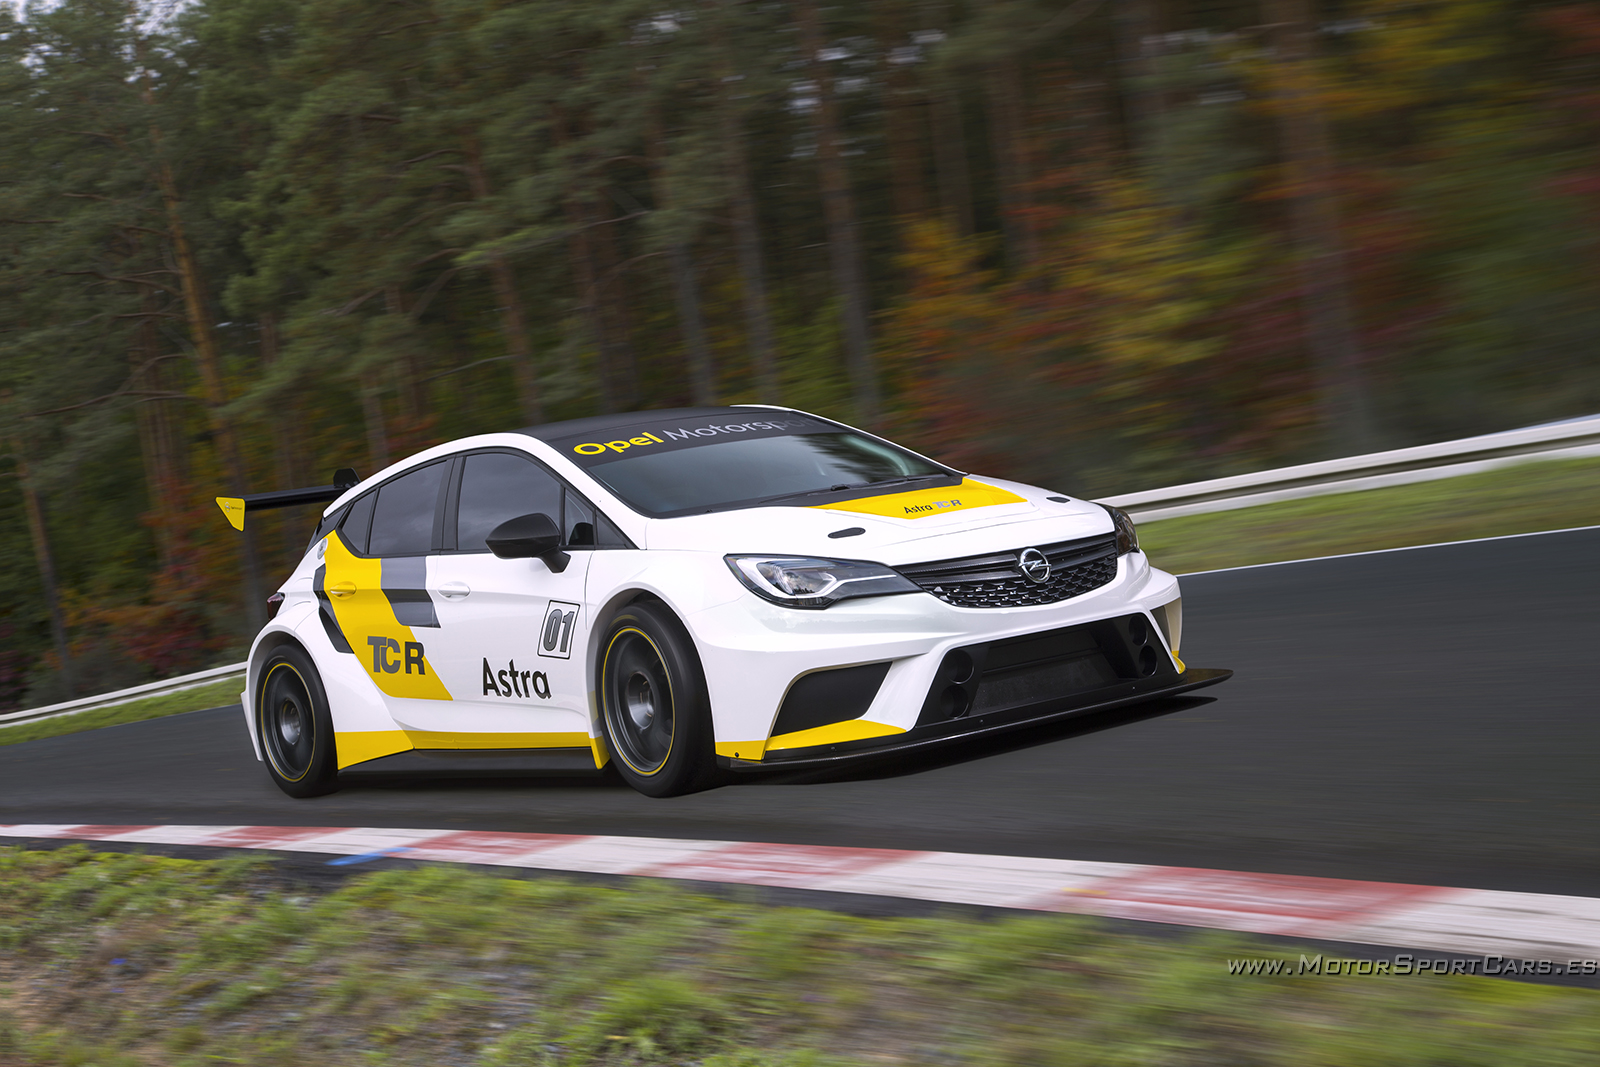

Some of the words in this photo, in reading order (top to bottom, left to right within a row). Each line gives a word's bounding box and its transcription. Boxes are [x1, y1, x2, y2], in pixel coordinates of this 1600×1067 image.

[573, 432, 664, 455] Opel
[903, 504, 933, 514] Astra
[932, 499, 962, 509] TCR
[543, 608, 575, 653] 01
[367, 635, 426, 675] TCR
[482, 657, 552, 700] Astra
